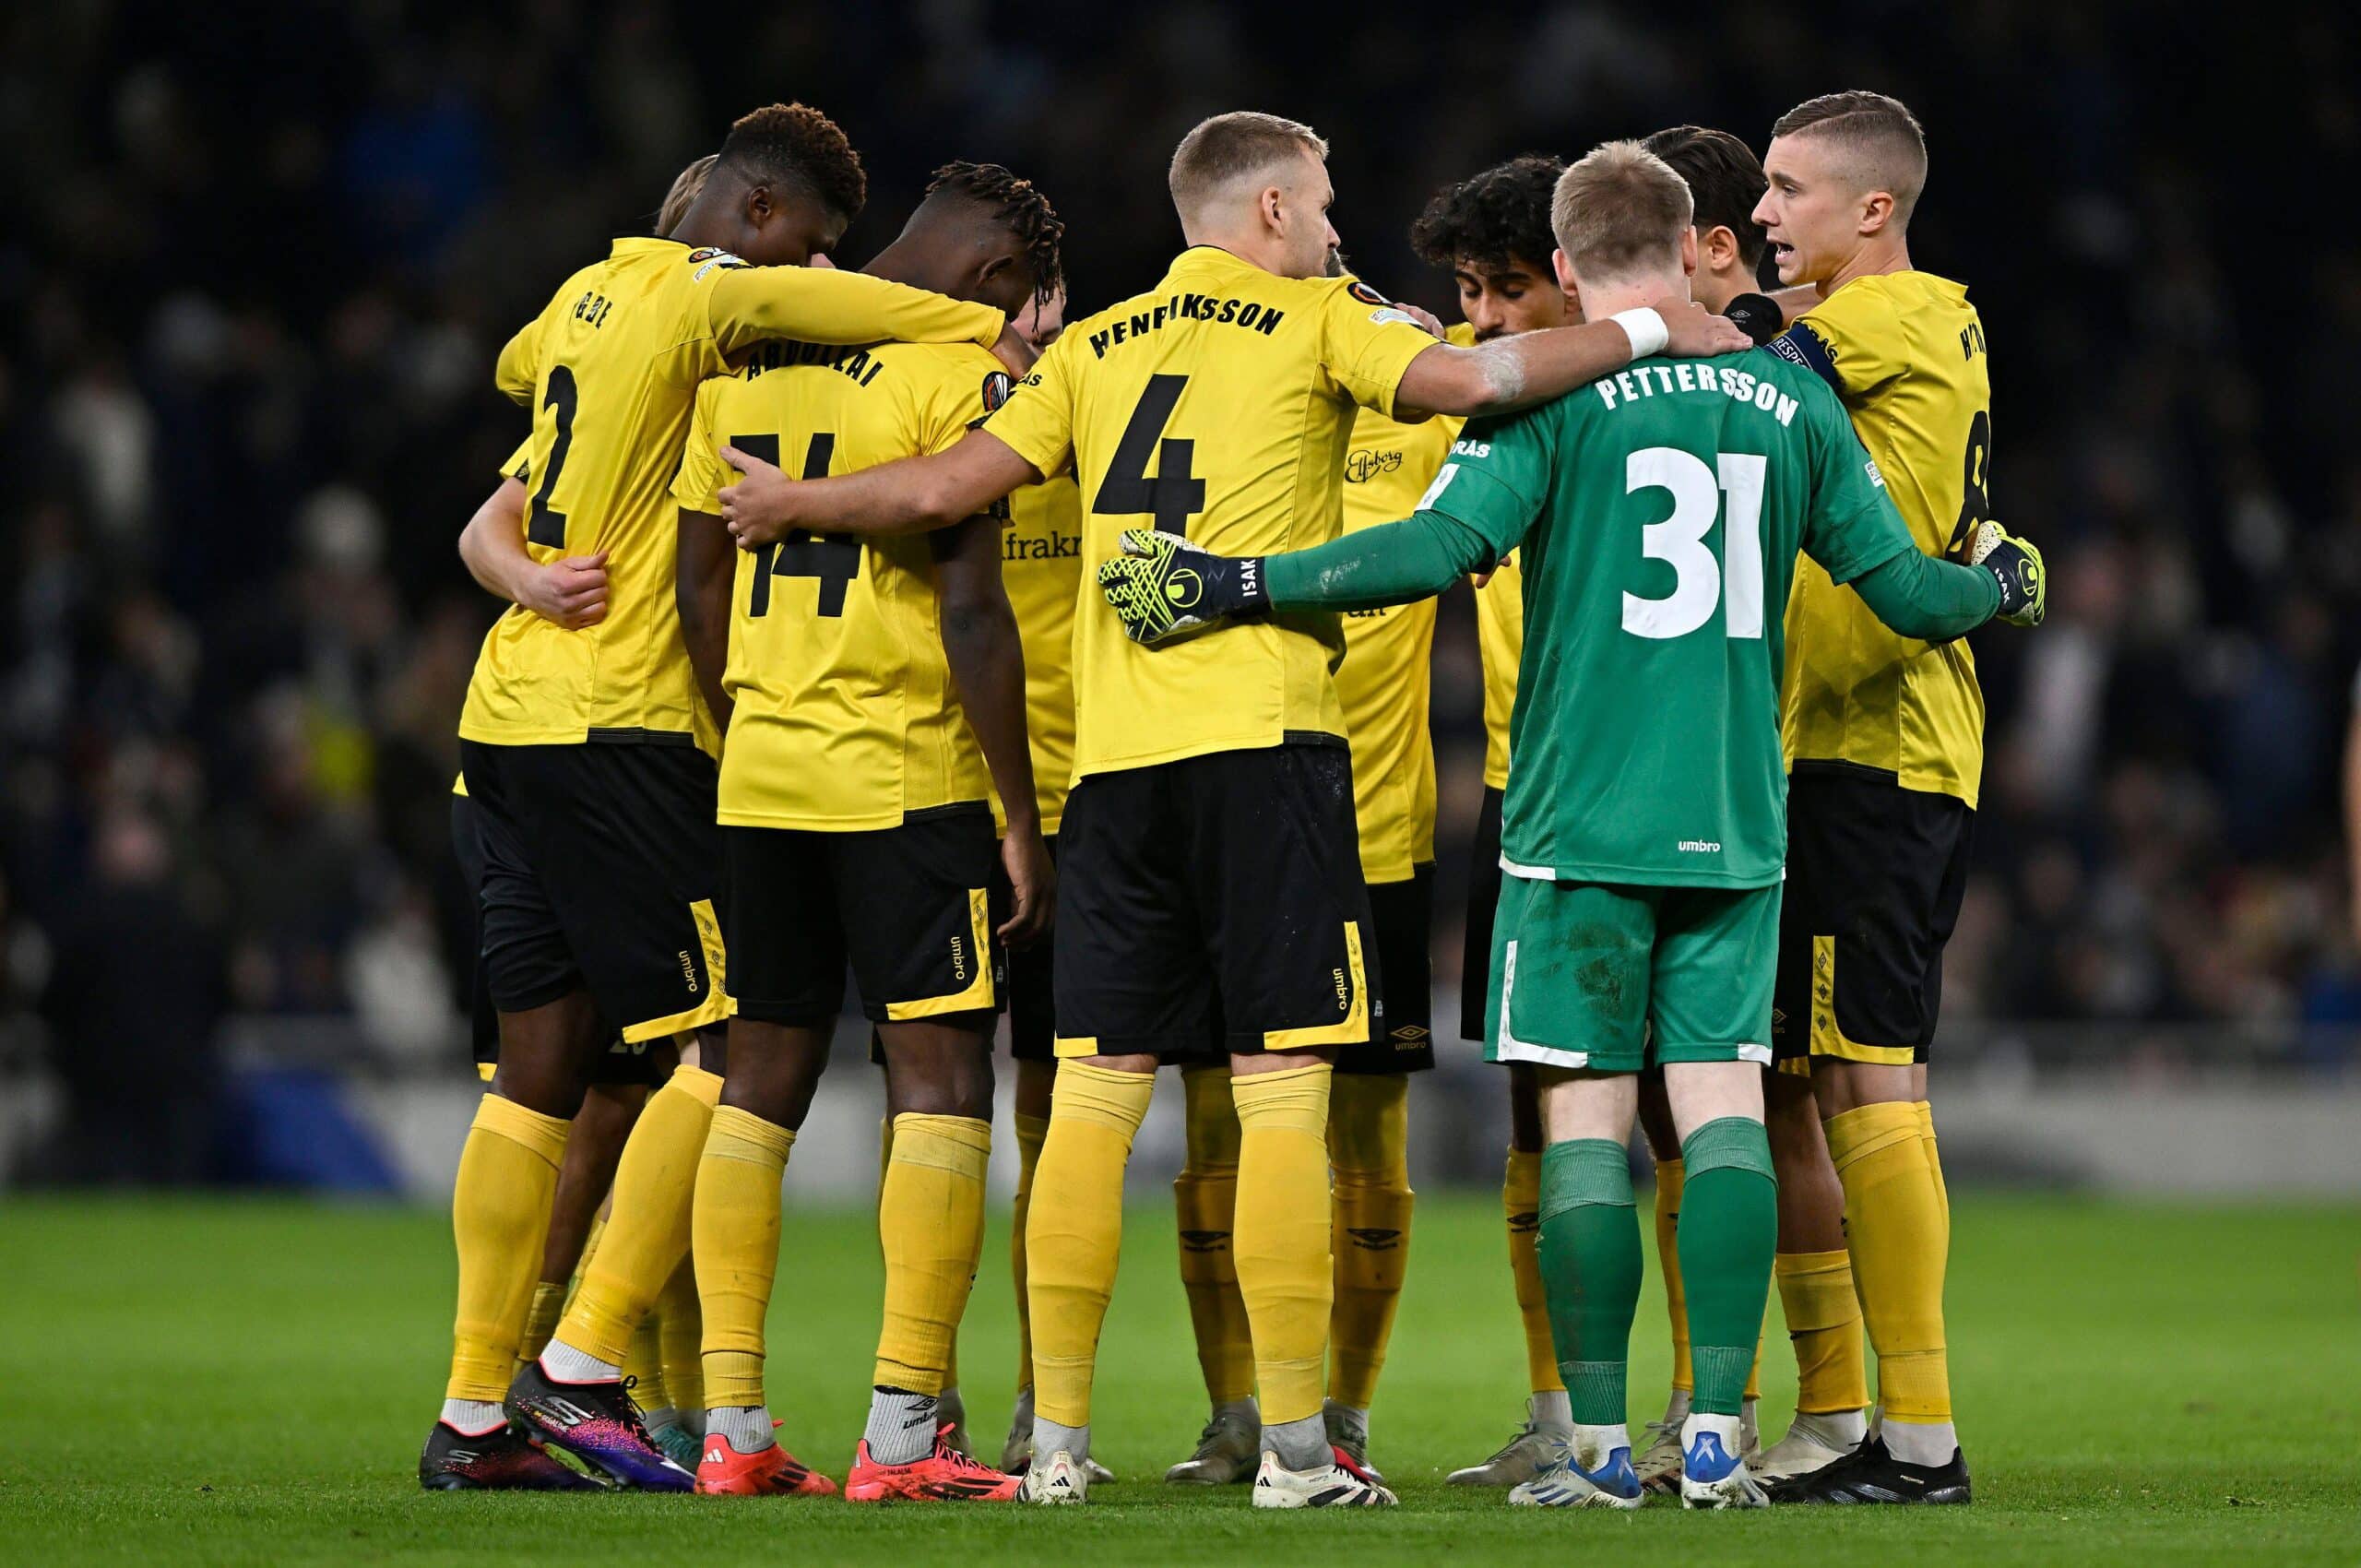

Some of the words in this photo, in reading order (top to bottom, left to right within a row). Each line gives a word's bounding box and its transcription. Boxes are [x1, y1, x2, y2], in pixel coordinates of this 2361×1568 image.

[1595, 363, 1798, 427] PETTERSSON
[528, 365, 578, 550] 2
[1092, 374, 1205, 540] 4
[730, 433, 860, 617] 14
[1621, 447, 1767, 638] 31
[1240, 559, 1257, 597] ISAK
[1994, 567, 2010, 604] ISAK
[1679, 838, 1721, 852] umbro
[679, 950, 698, 992] umbro
[950, 936, 965, 980] umbro
[1333, 968, 1347, 1010] umbro
[1394, 1040, 1427, 1051] umbro
